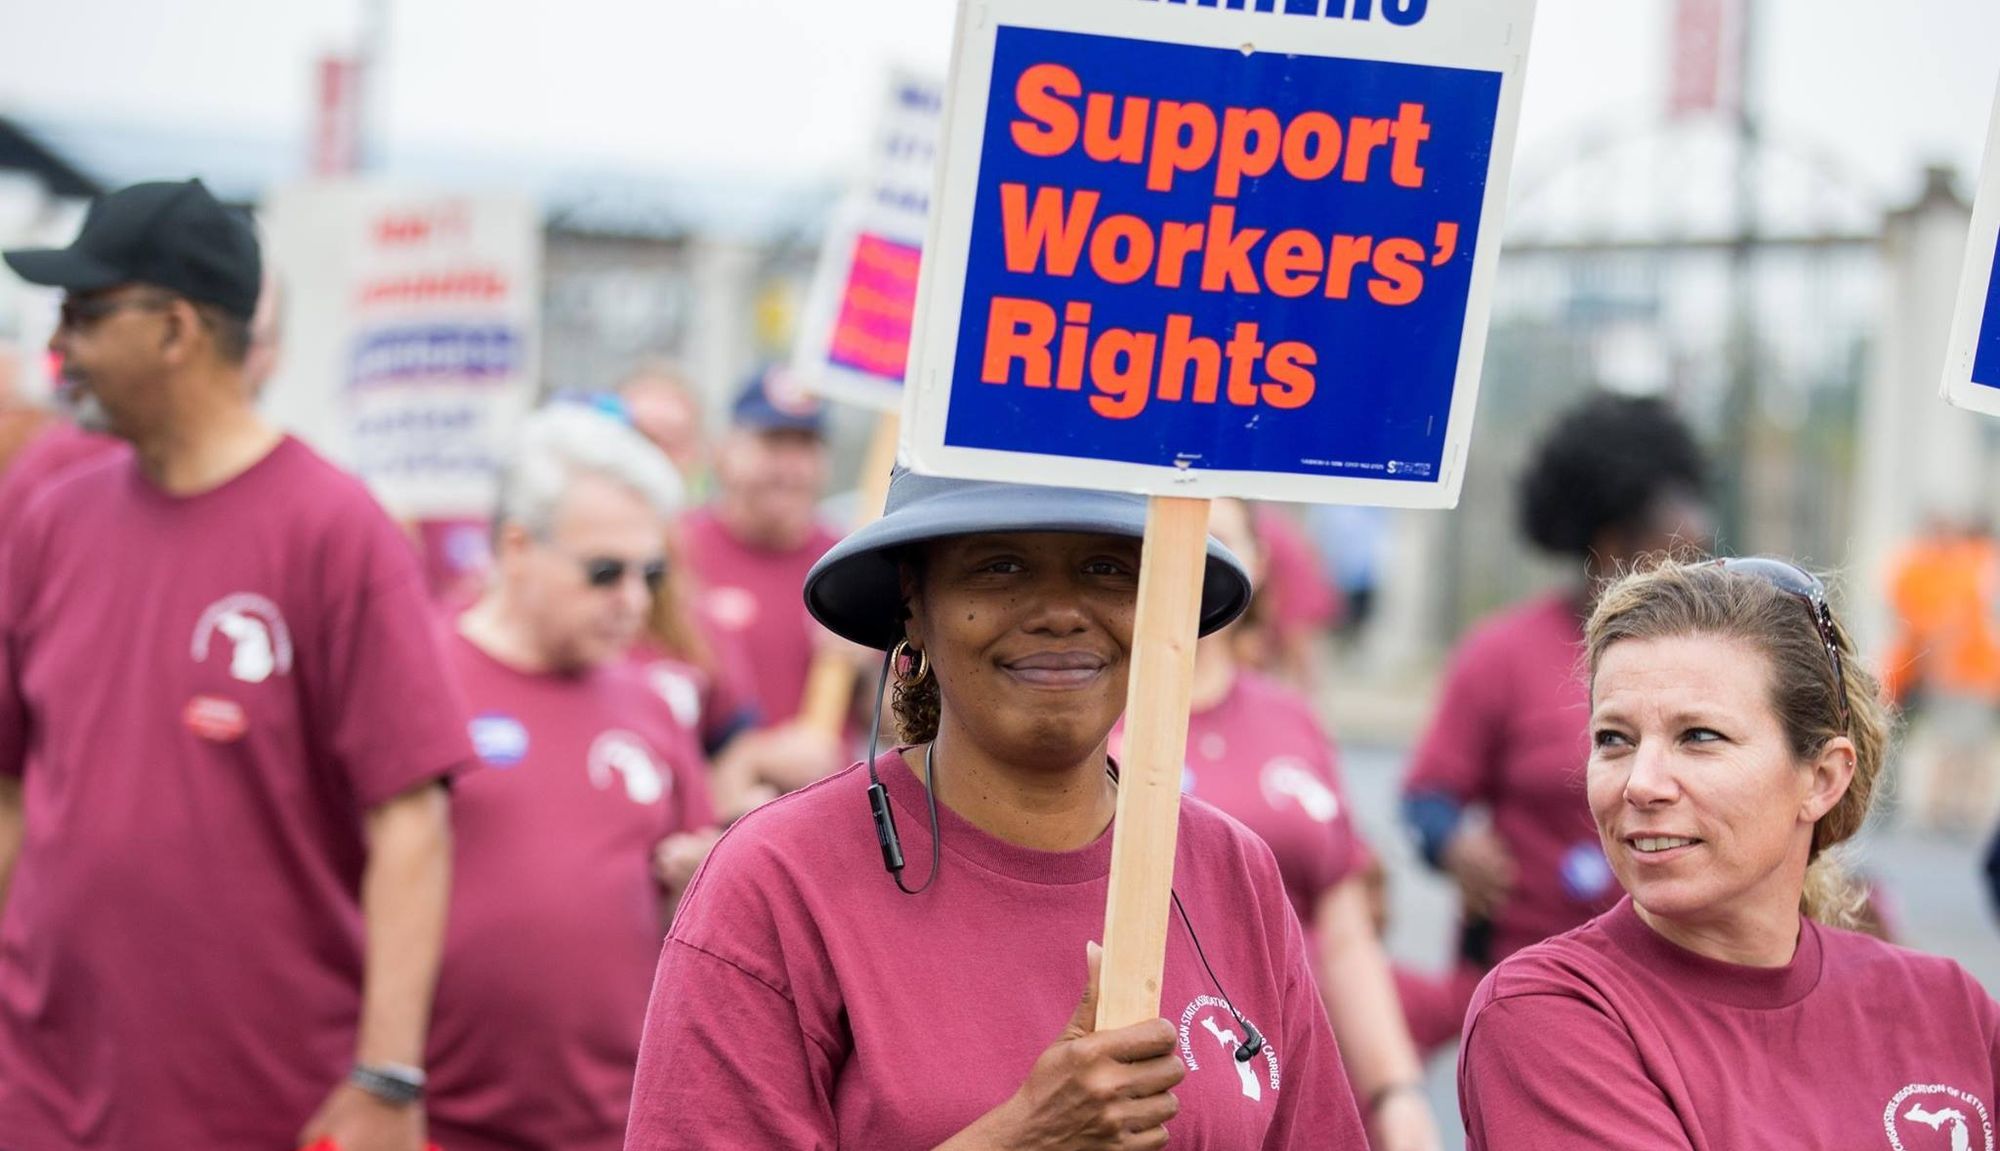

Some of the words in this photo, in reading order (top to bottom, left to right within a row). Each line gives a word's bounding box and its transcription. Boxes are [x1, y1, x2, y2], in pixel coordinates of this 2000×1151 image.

[1011, 64, 1430, 198] Support
[1001, 183, 1458, 306] Workers’
[982, 297, 1317, 419] Rights
[1181, 1001, 1199, 1027] STATE
[1179, 1026, 1199, 1072] MICHIGAN
[1262, 1045, 1280, 1091] CARRIERS
[1946, 1085, 1960, 1098] OF
[1960, 1091, 1989, 1122] LETTER
